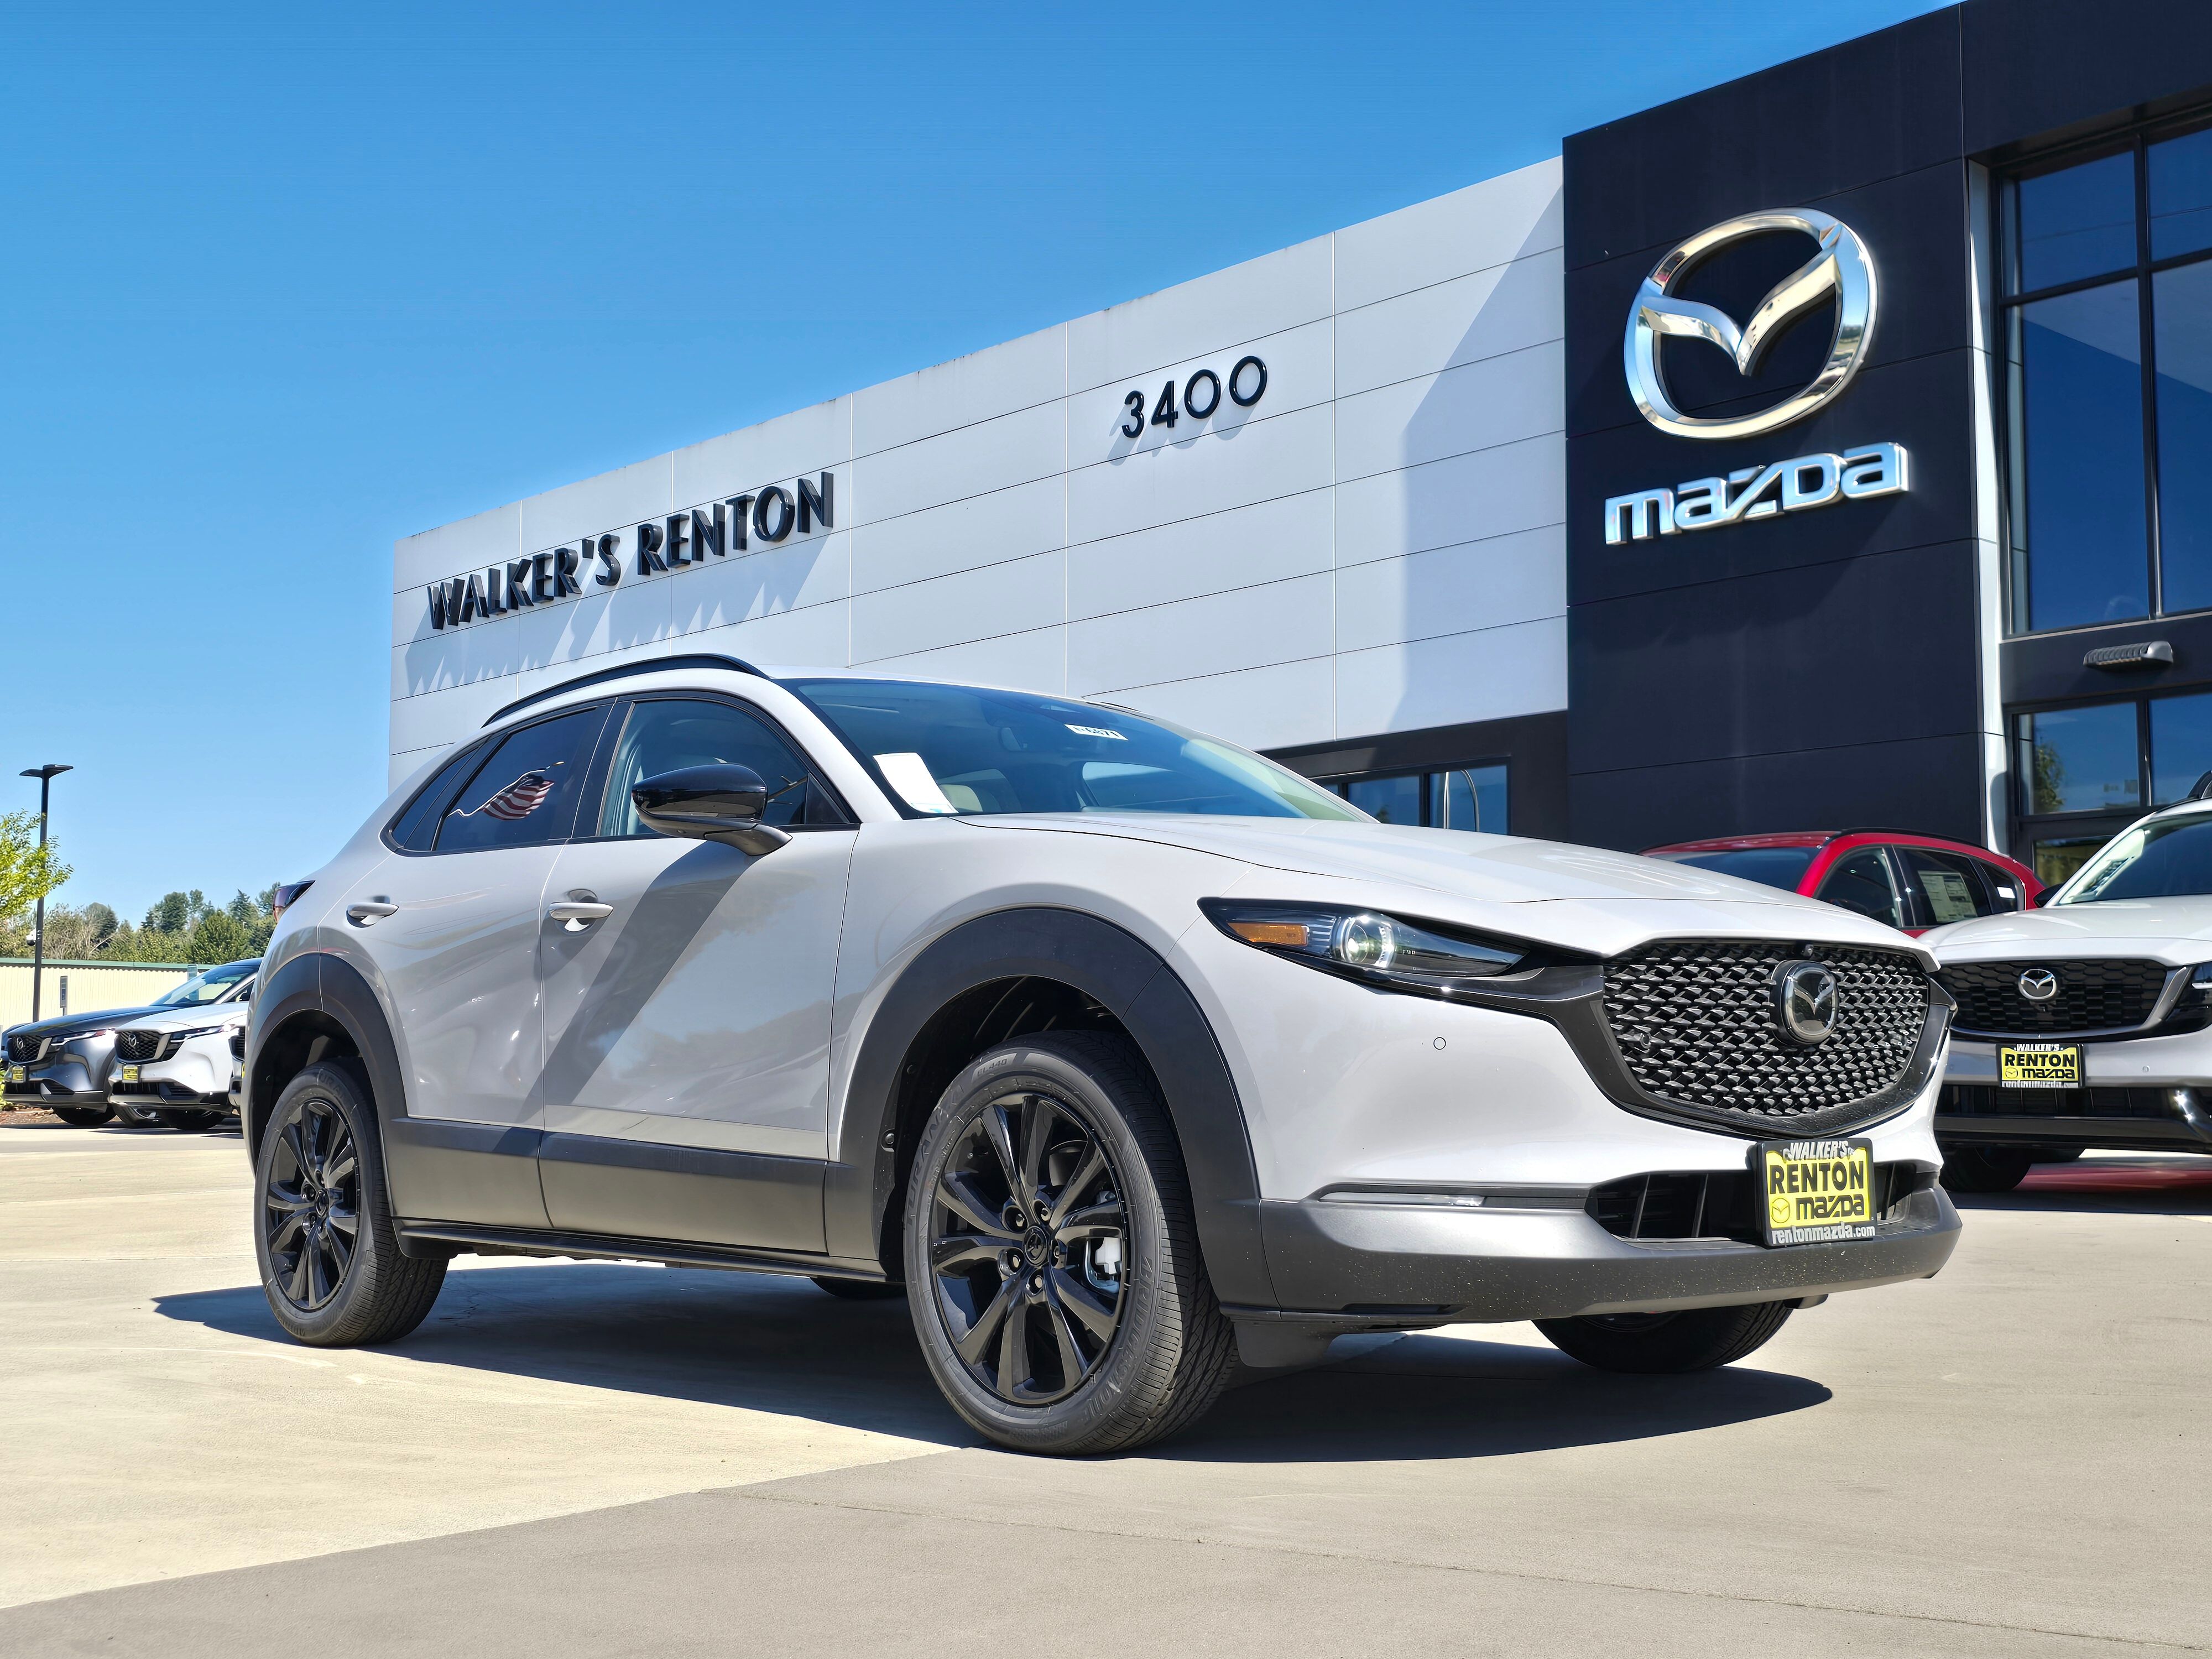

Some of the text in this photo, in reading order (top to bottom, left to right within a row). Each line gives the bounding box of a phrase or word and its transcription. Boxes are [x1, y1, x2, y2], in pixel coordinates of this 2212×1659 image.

[1121, 355, 1268, 438] 3400
[1605, 441, 1910, 545] mazda
[427, 471, 834, 630] WALKER'S RENTON
[2004, 1053, 2075, 1067] RENTON
[2016, 1044, 2060, 1052] WALKER'S
[2022, 1068, 2075, 1079] mazda
[1790, 1140, 1849, 1161] WALKER'S
[1770, 1161, 1864, 1194] RENTON
[1795, 1194, 1865, 1220] mazda
[1771, 1220, 1876, 1244] rentonmazda.com
